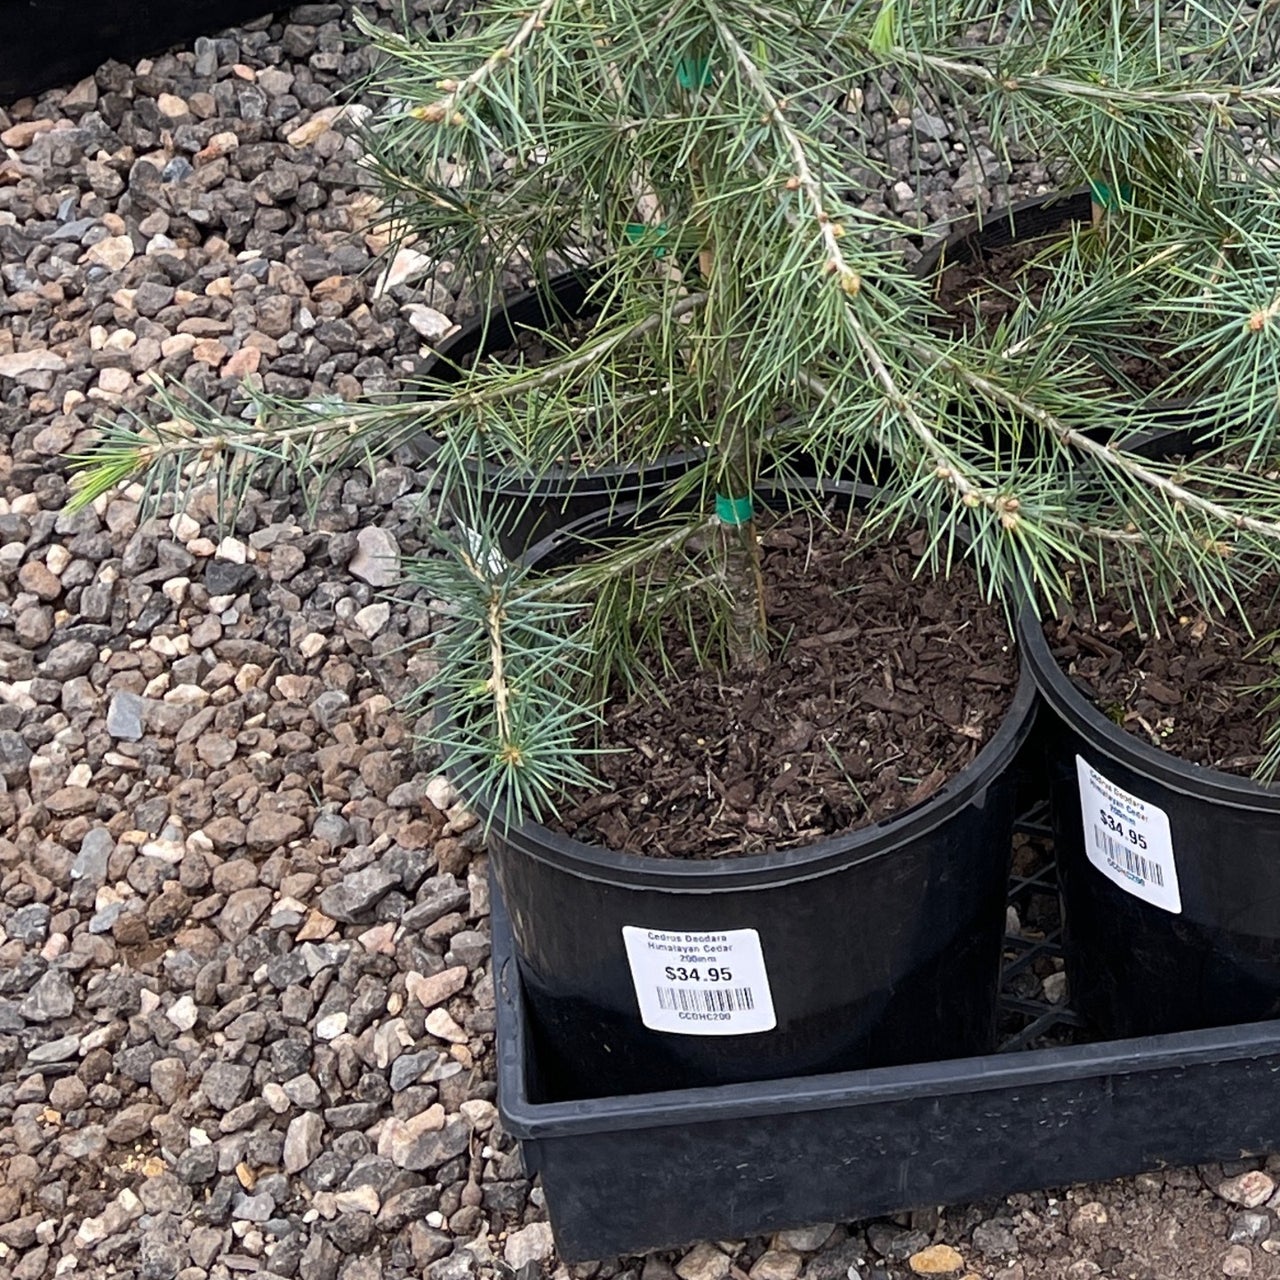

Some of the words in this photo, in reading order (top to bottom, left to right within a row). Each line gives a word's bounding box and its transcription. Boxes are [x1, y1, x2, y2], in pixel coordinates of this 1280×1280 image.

[1100, 808, 1148, 850] $34.95
[647, 931, 682, 942] Cedrus
[685, 934, 727, 943] Deodara
[647, 941, 700, 954] Himalayan
[703, 944, 734, 953] Cedar
[680, 954, 717, 963] 200mm
[665, 966, 733, 982] $34.95
